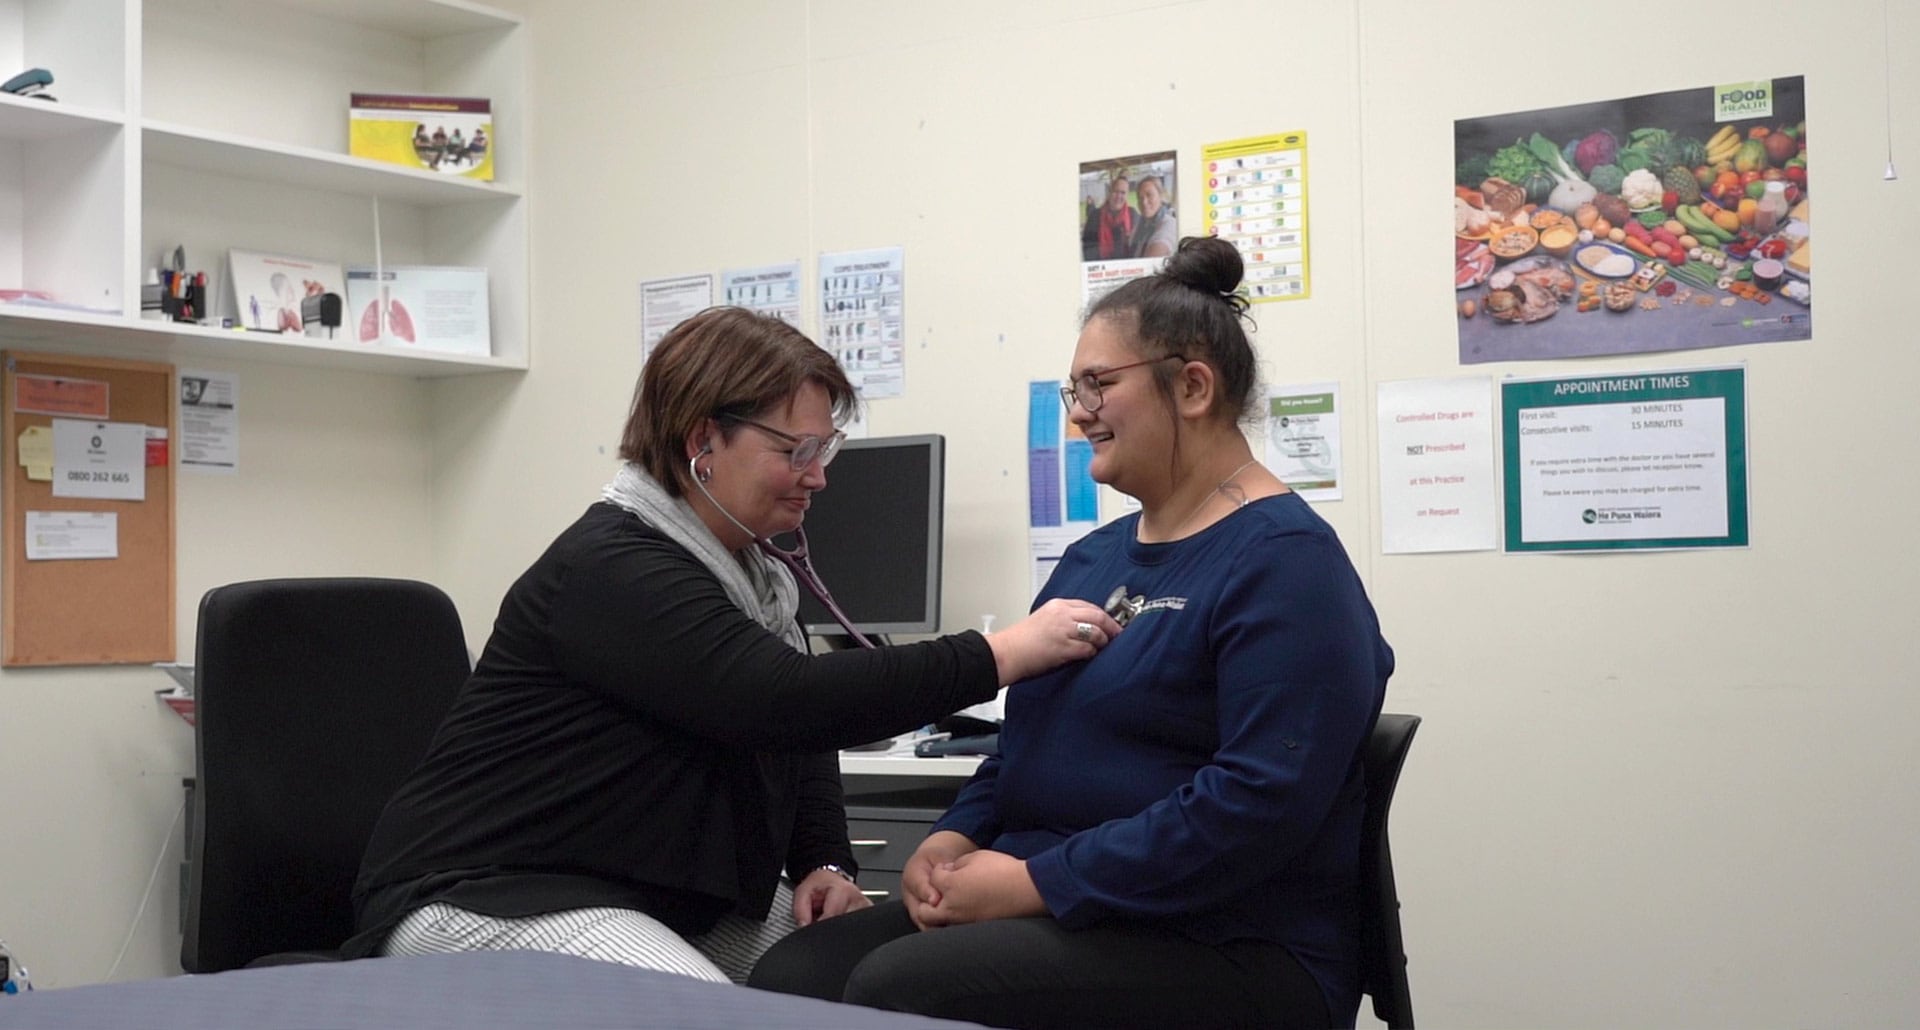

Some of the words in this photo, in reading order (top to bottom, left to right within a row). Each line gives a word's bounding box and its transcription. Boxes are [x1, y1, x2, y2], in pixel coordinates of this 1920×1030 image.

[1720, 89, 1766, 104] FOOD
[854, 260, 890, 270] TREATMENT
[757, 271, 792, 281] TREATMENT
[1554, 377, 1646, 396] APPOINTMENT
[1650, 375, 1690, 390] TIMES
[1631, 405, 1642, 414] 30
[1644, 404, 1683, 414] MINUTES
[1396, 412, 1436, 423] Controlled
[1437, 411, 1460, 422] Drugs
[1520, 411, 1538, 420] First
[1540, 410, 1557, 420] visit:
[1520, 426, 1568, 436] Consecutive
[1570, 424, 1593, 434] visits:
[1631, 421, 1642, 430] 15
[1644, 420, 1684, 429] MINUTES
[1406, 445, 1424, 456] NOT
[1425, 443, 1466, 453] Prescribed
[68, 471, 90, 481] 0800
[1409, 478, 1418, 486] at
[1419, 476, 1433, 485] this
[1434, 476, 1465, 484] Practice
[1428, 508, 1460, 517] Request
[1598, 512, 1610, 520] He
[1611, 511, 1632, 520] Puna
[1633, 510, 1662, 519] Waiora
